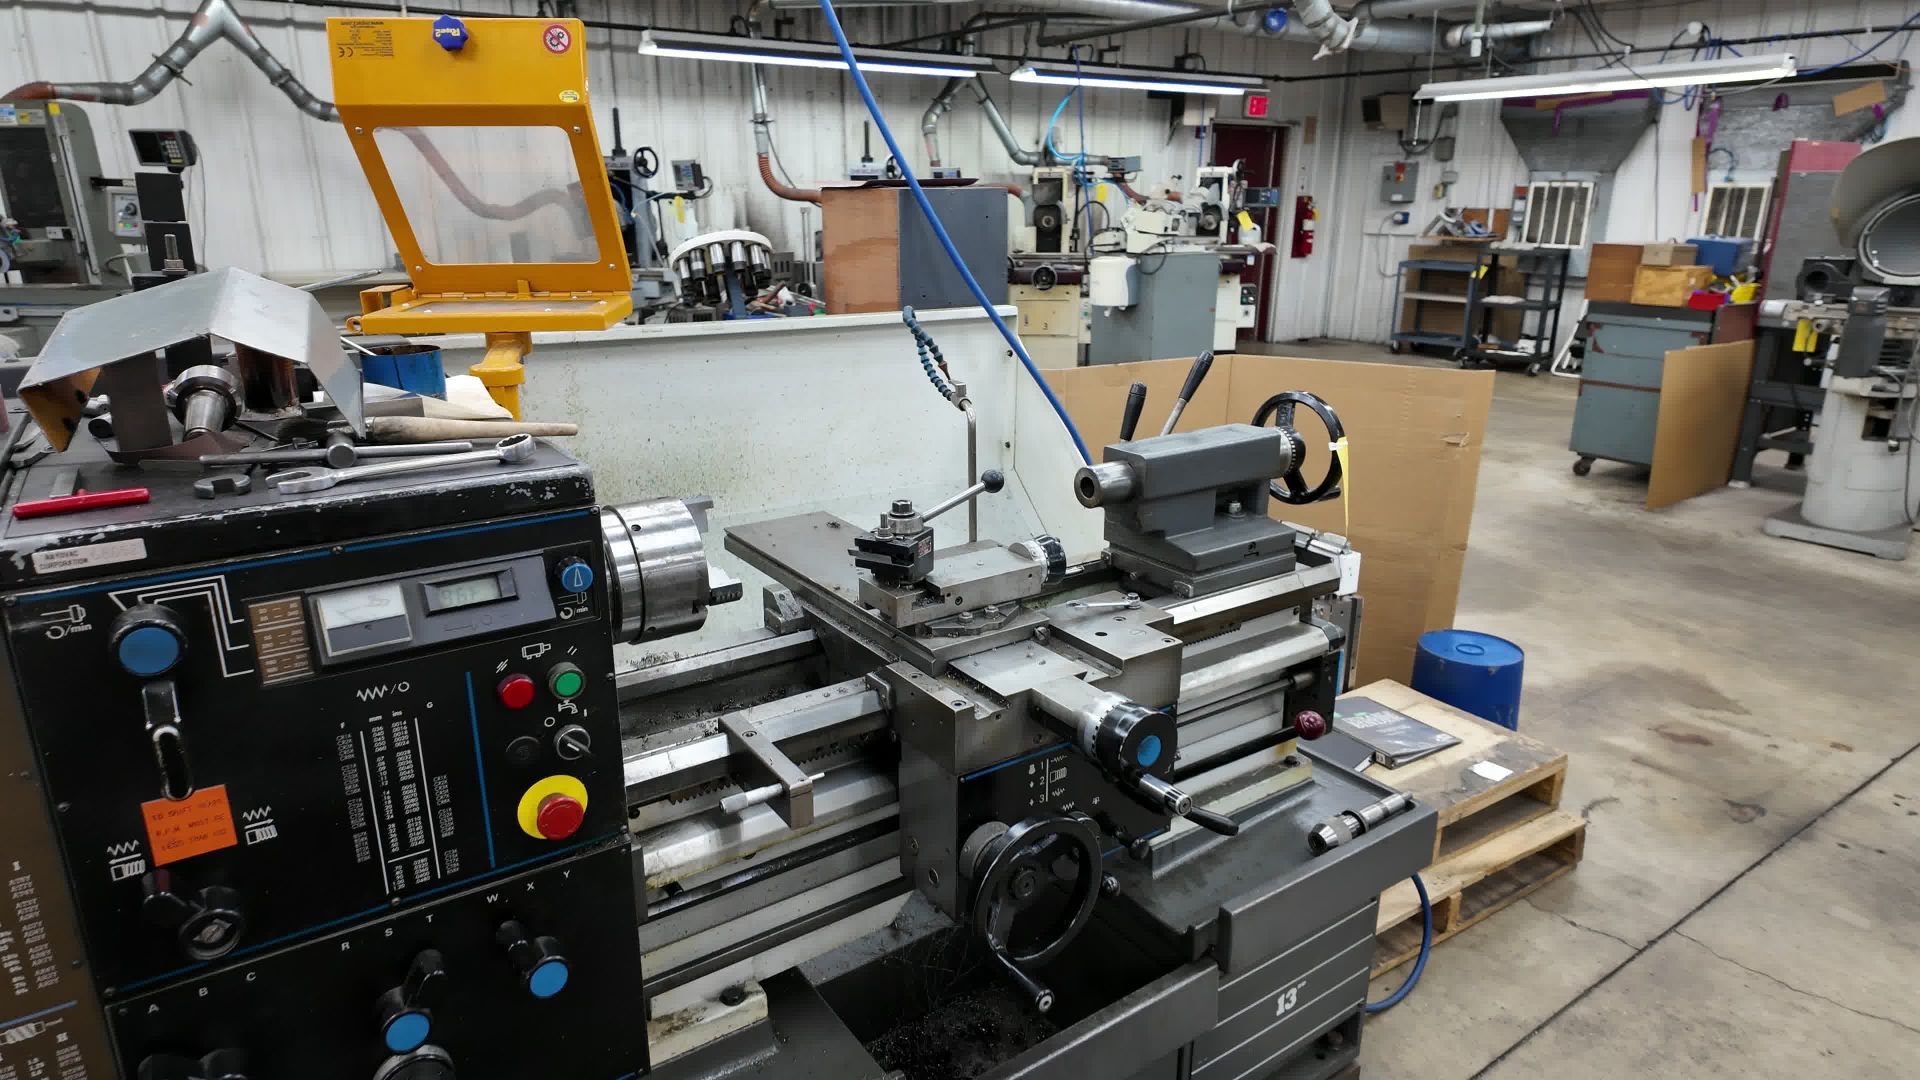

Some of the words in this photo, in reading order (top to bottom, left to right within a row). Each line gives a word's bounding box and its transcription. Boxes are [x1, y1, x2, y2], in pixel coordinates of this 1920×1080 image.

[1040, 776, 1045, 785] 2
[1039, 794, 1045, 803] 3
[486, 893, 499, 904] W
[527, 881, 536, 892] X
[563, 870, 571, 879] Y
[341, 941, 351, 952] R
[385, 928, 394, 937] S
[426, 914, 434, 923] T
[148, 1003, 160, 1014] A
[199, 986, 209, 997] B
[246, 972, 257, 982] C
